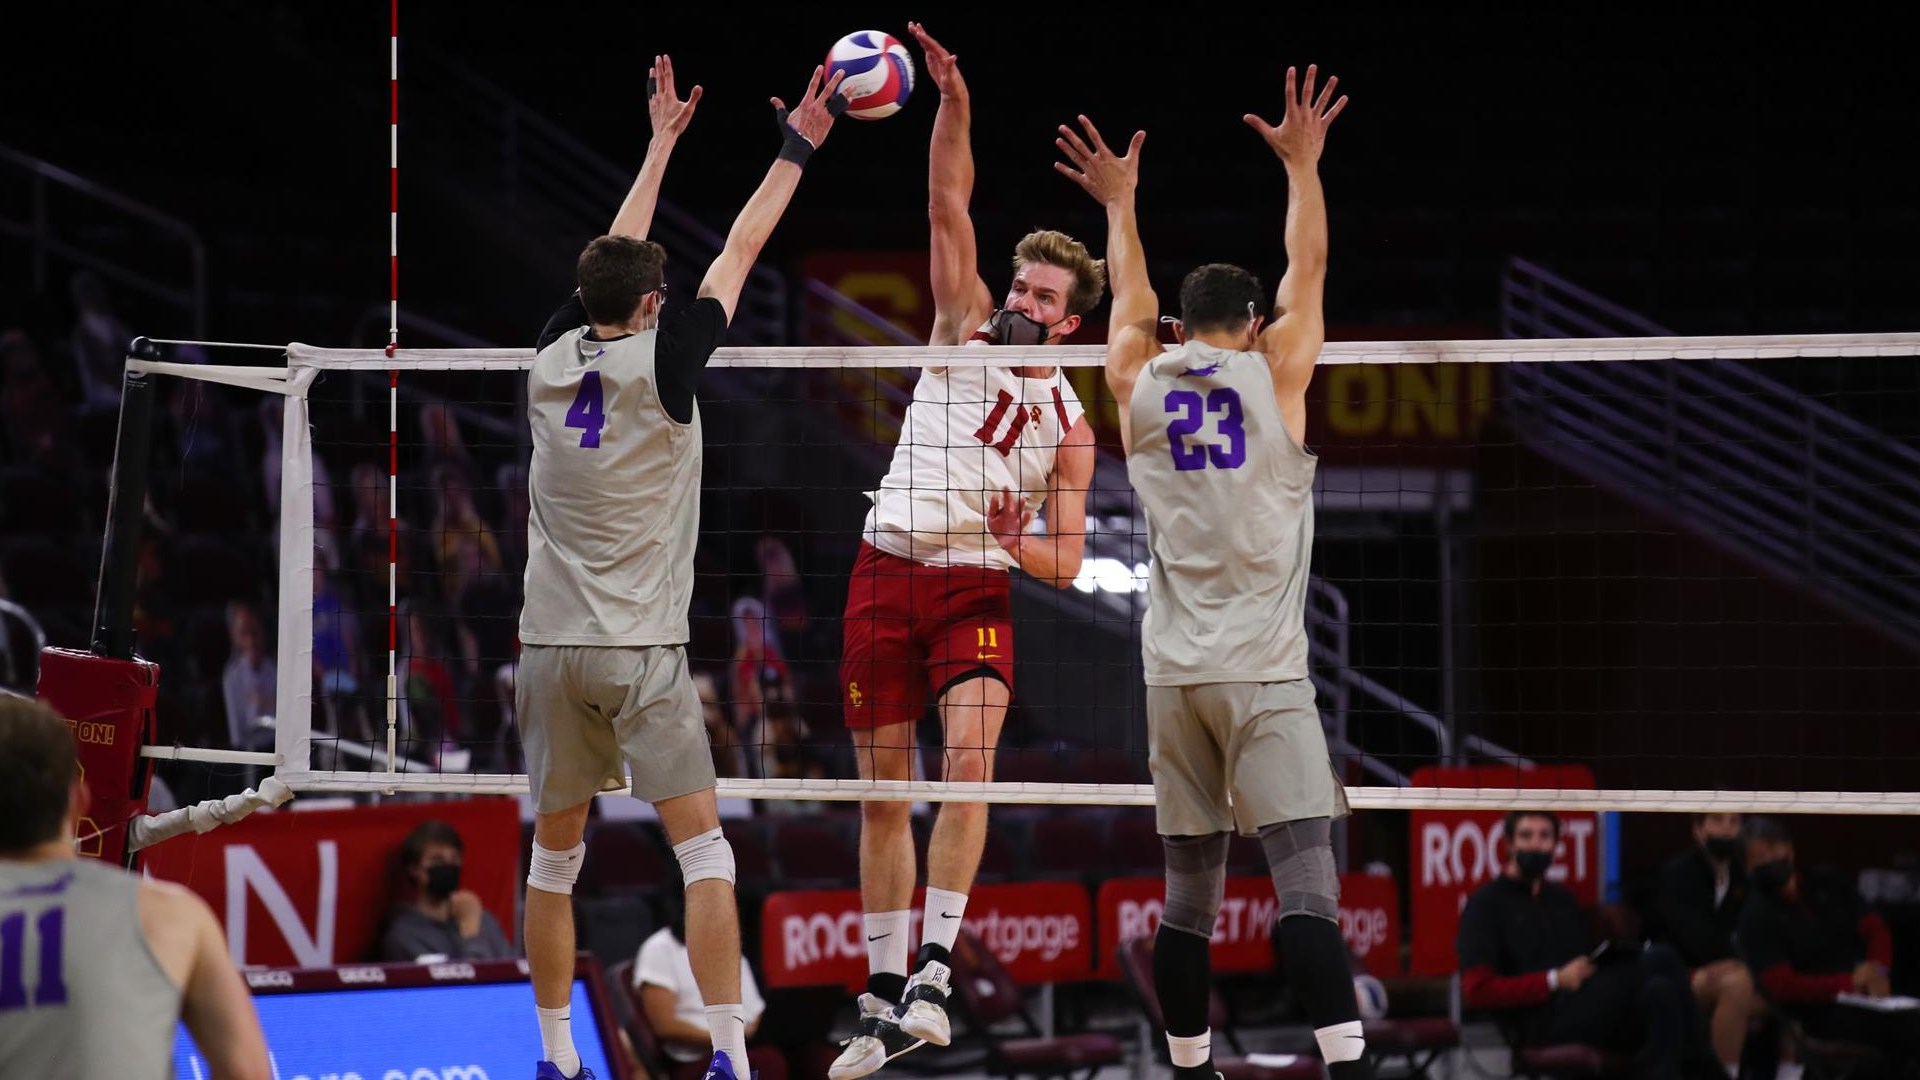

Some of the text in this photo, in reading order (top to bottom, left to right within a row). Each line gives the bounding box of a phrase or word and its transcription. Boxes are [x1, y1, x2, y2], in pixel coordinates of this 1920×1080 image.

[564, 370, 606, 449] 4
[972, 388, 1030, 458] 11
[1164, 387, 1247, 471] 23
[976, 626, 998, 648] 11
[79, 721, 115, 745] ON!
[1421, 817, 1595, 888] ROCET
[1115, 897, 1247, 946] ROET
[0, 907, 67, 1010] 11
